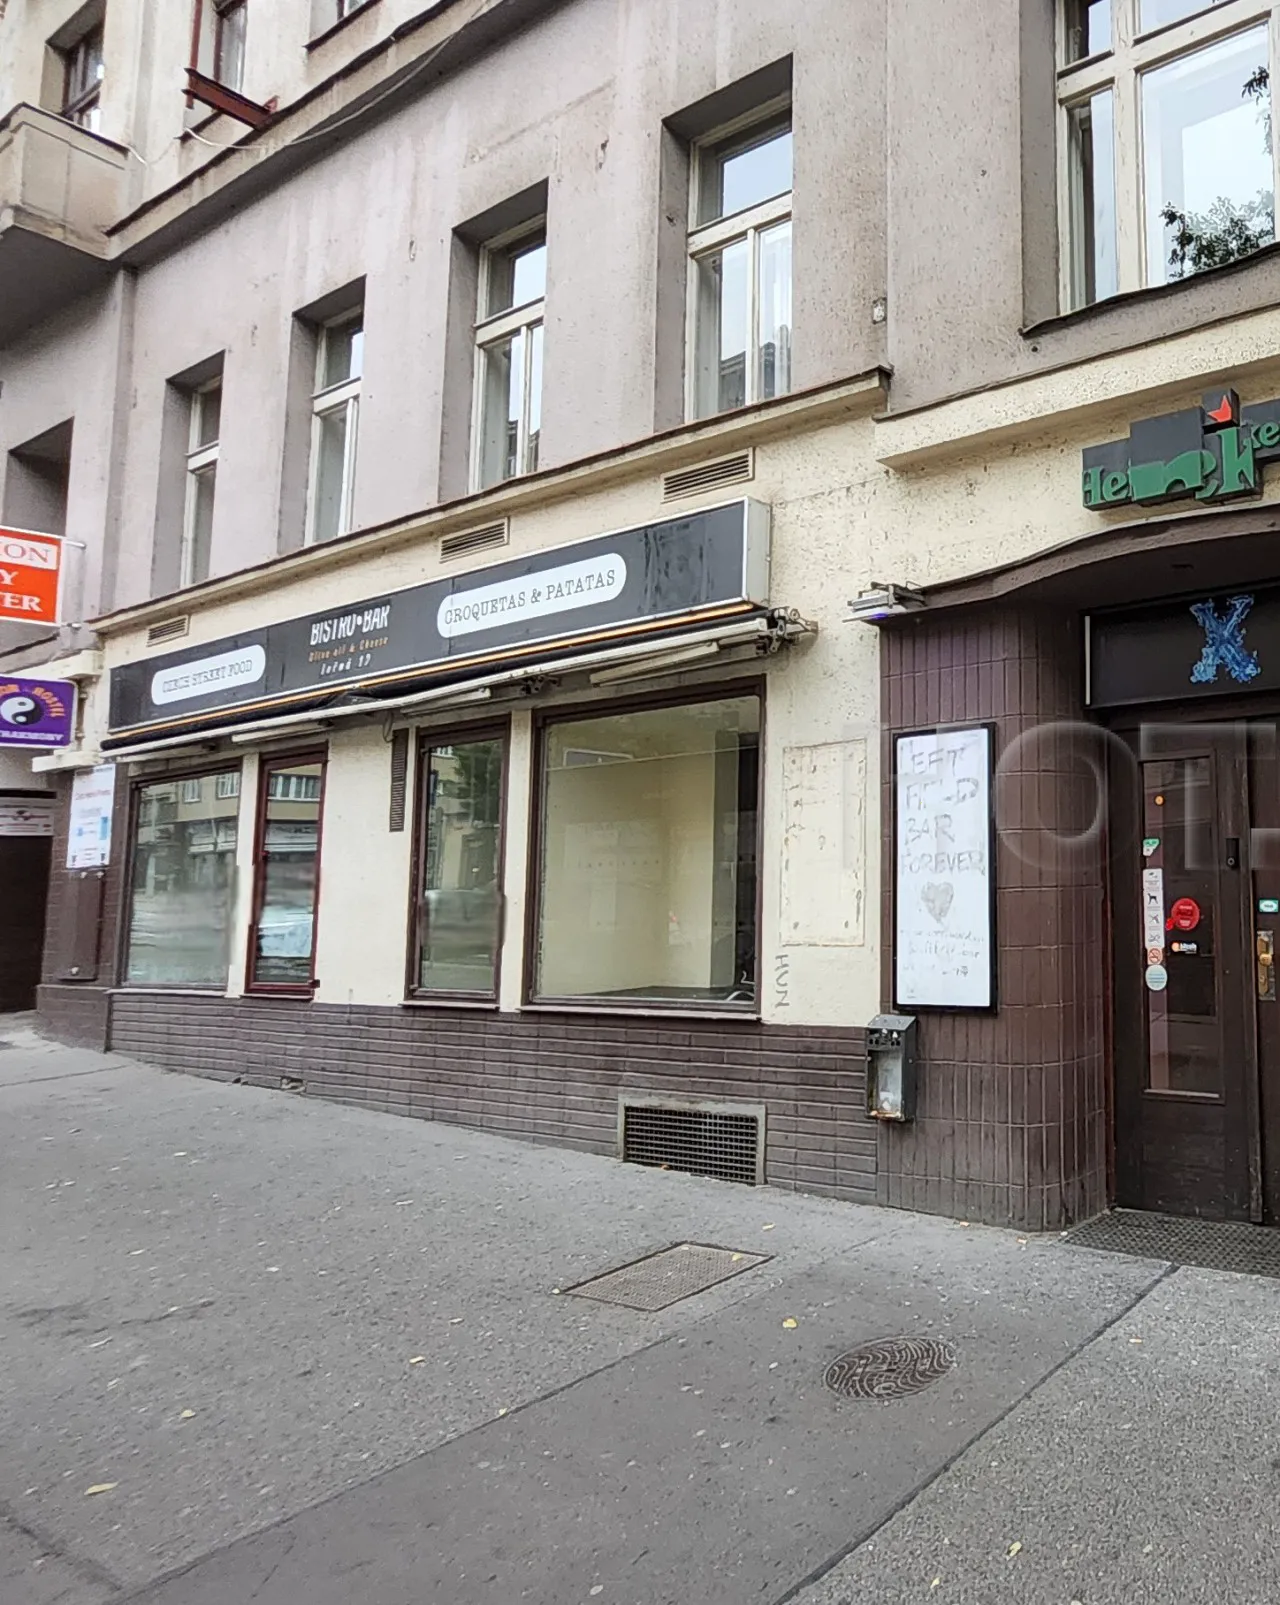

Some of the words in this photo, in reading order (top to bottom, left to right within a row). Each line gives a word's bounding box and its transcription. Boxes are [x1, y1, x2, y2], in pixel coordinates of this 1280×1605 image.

[444, 591, 526, 625] CROQUETAS
[530, 588, 542, 604] &
[546, 569, 615, 601] PATATAS
[362, 605, 391, 633] BAR
[228, 659, 253, 677] FOOD
